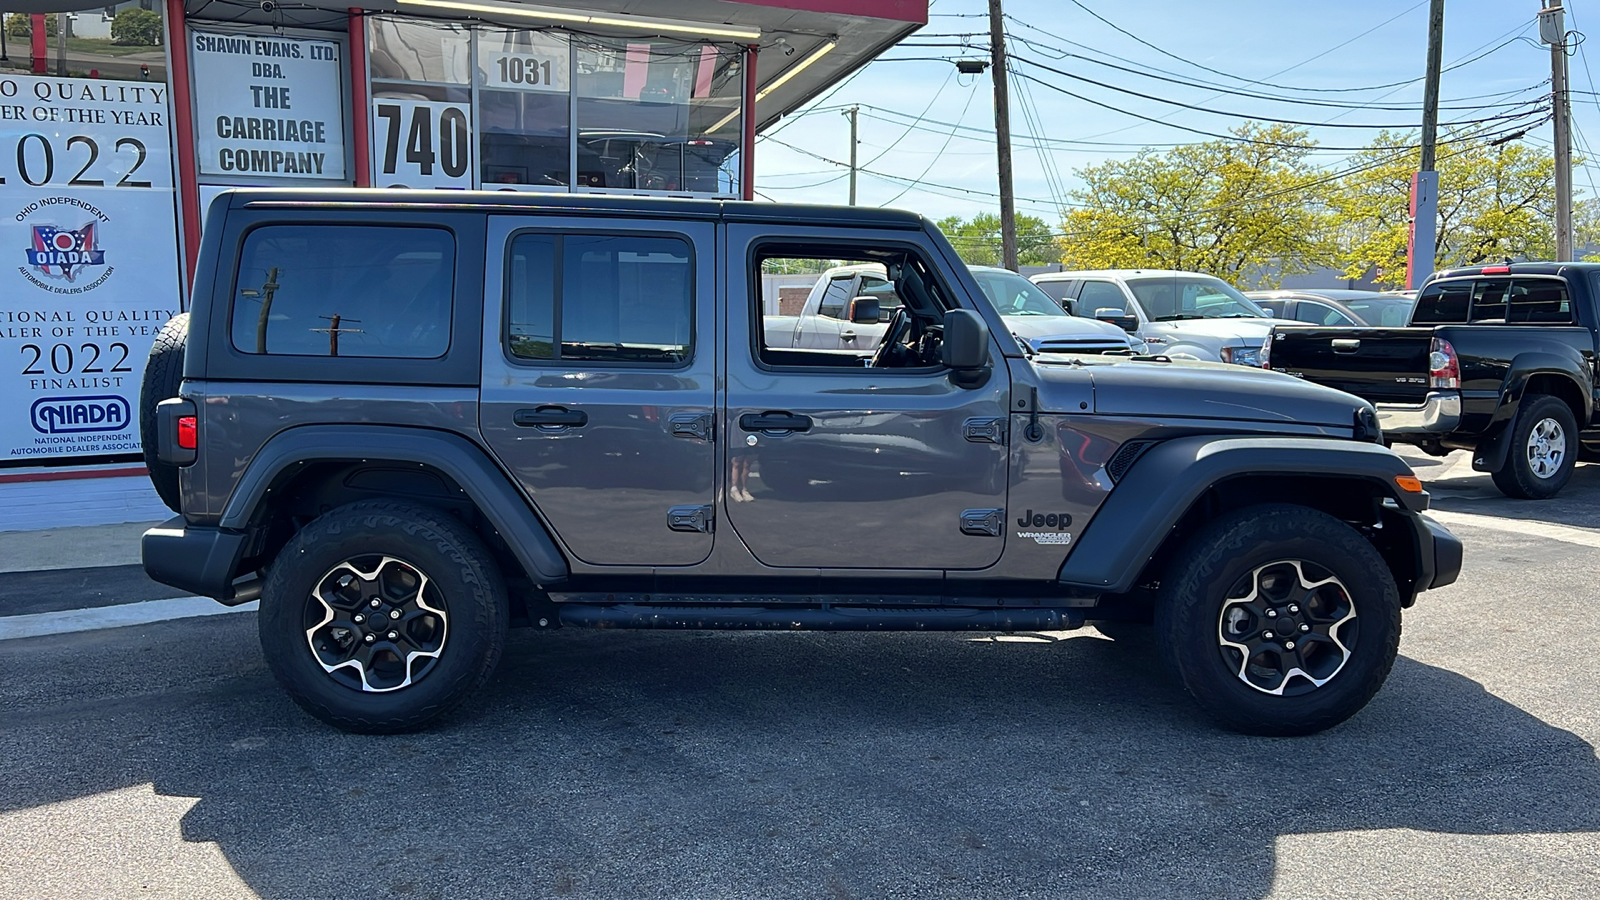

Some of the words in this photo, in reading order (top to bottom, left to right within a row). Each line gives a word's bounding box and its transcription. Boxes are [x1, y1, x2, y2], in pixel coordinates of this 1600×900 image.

[196, 35, 250, 55] SHAWN
[255, 40, 304, 59] EVANS.
[310, 45, 338, 61] LTD.
[252, 62, 286, 79] DBA.
[497, 57, 551, 85] 1031
[33, 82, 164, 105] QUALITY
[250, 85, 291, 110] THE
[32, 106, 59, 122] OF
[65, 108, 106, 124] THE
[111, 110, 164, 127] YEAR
[216, 115, 326, 144] CARRIAGE
[378, 104, 468, 178] 740
[0, 133, 152, 187] 022
[219, 148, 326, 175] COMPANY
[15, 202, 39, 222] OHIO
[38, 196, 111, 223] INDEPENDENT
[36, 251, 93, 264] OIADA
[18, 265, 54, 293] AUTOMOBILE
[54, 287, 83, 295] DEALERS
[83, 265, 115, 293] ASSOCIATION
[86, 310, 176, 324] QUALITY
[52, 326, 75, 338] OF
[83, 326, 120, 337] THE
[128, 325, 161, 336] YEA
[20, 342, 132, 375] 2022
[30, 377, 124, 390] FINALIST
[39, 403, 122, 434] NIADA
[10, 446, 63, 456] AUTOMOBILE
[66, 445, 100, 453] DEALERS
[34, 437, 76, 445] NATIONAL
[77, 433, 132, 443] INDEPENDENT
[1017, 509, 1072, 531] Jeep
